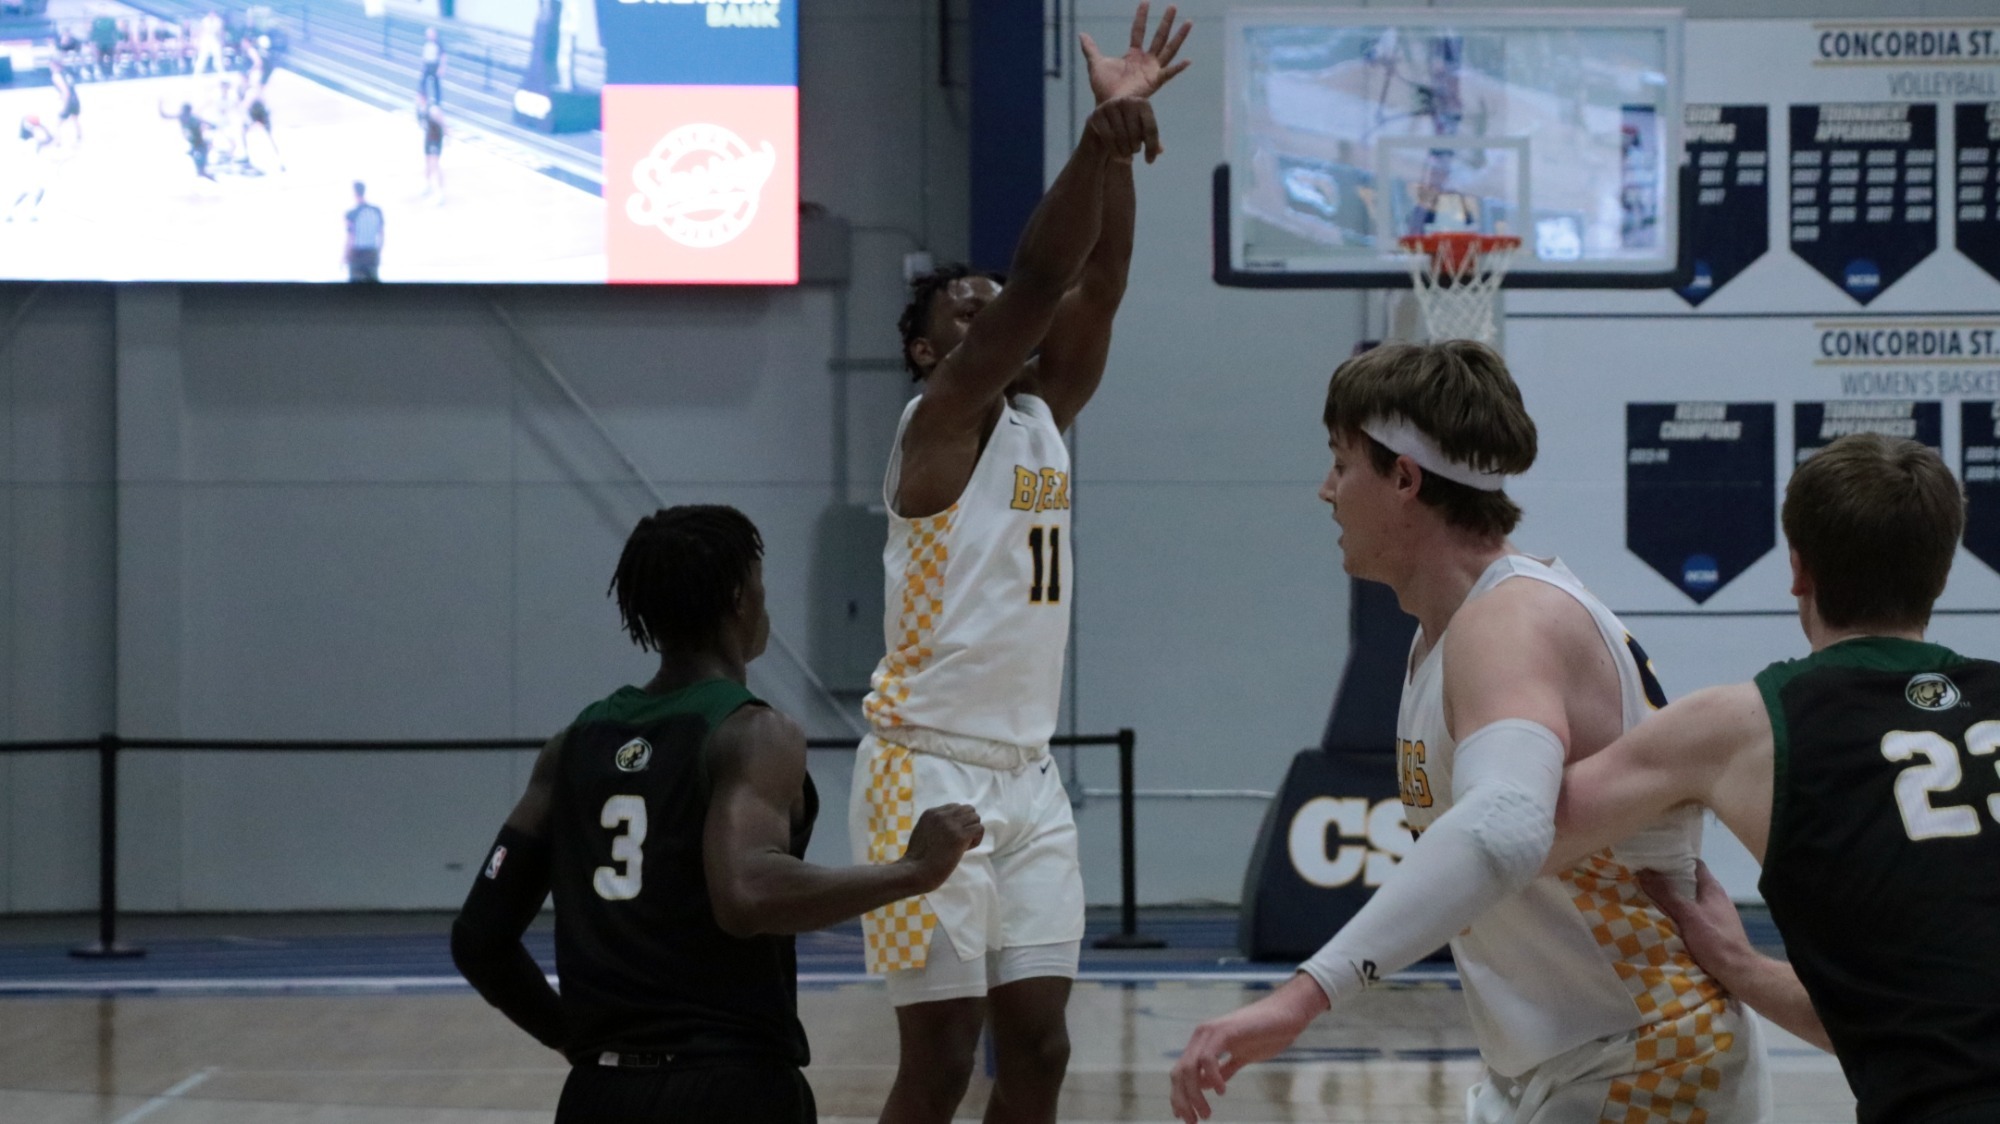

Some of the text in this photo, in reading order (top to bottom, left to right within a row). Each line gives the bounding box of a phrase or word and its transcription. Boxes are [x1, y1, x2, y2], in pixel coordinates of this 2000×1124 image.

[1819, 31, 1962, 57] CONCORDIA
[1887, 70, 1998, 98] VOLLEYBALL
[1820, 330, 1963, 357] CONCORDIA
[1840, 370, 1935, 396] WOMEN'S
[1028, 525, 1060, 604] 11
[593, 794, 648, 901] 3
